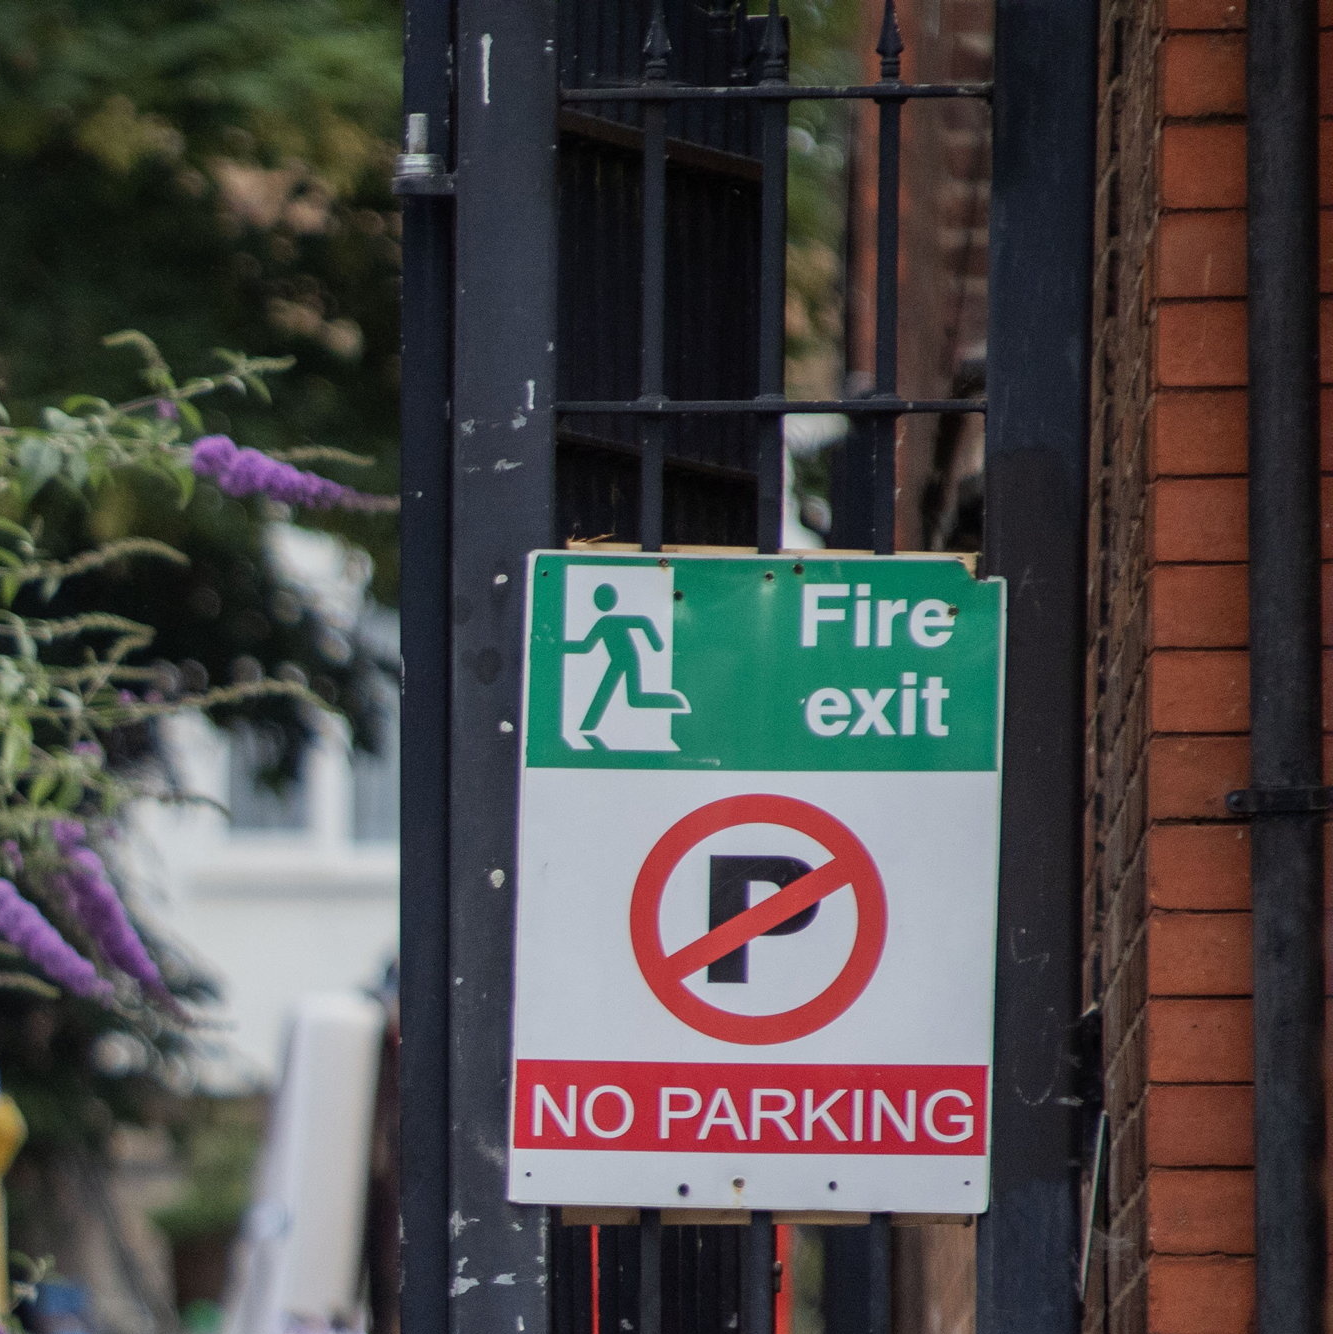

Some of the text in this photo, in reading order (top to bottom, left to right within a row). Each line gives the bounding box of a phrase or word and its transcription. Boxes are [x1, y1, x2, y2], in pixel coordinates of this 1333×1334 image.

[802, 583, 958, 648] Fire
[806, 672, 950, 737] exit
[707, 854, 822, 984] P
[532, 1083, 975, 1144] NO PARKING
